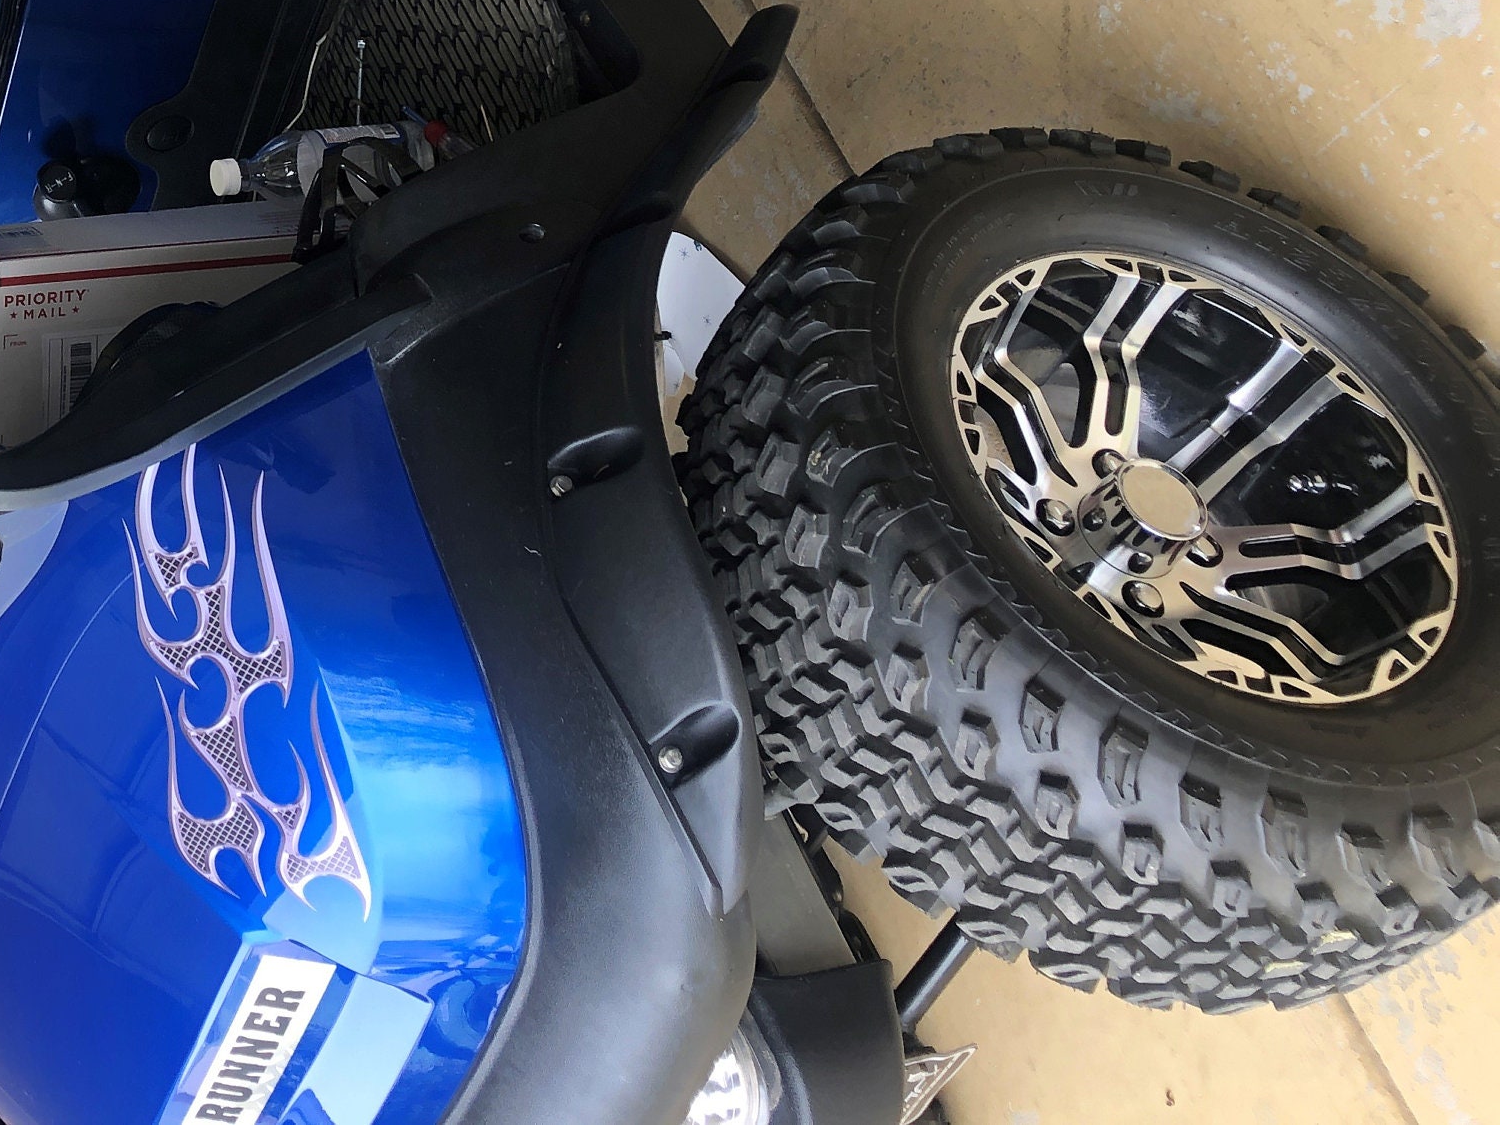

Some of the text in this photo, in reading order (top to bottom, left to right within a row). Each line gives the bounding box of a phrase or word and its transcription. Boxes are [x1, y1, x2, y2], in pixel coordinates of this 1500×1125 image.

[5, 289, 86, 308] PRIORITY
[23, 306, 66, 320] MAIL
[195, 987, 306, 1124] RUNNER
